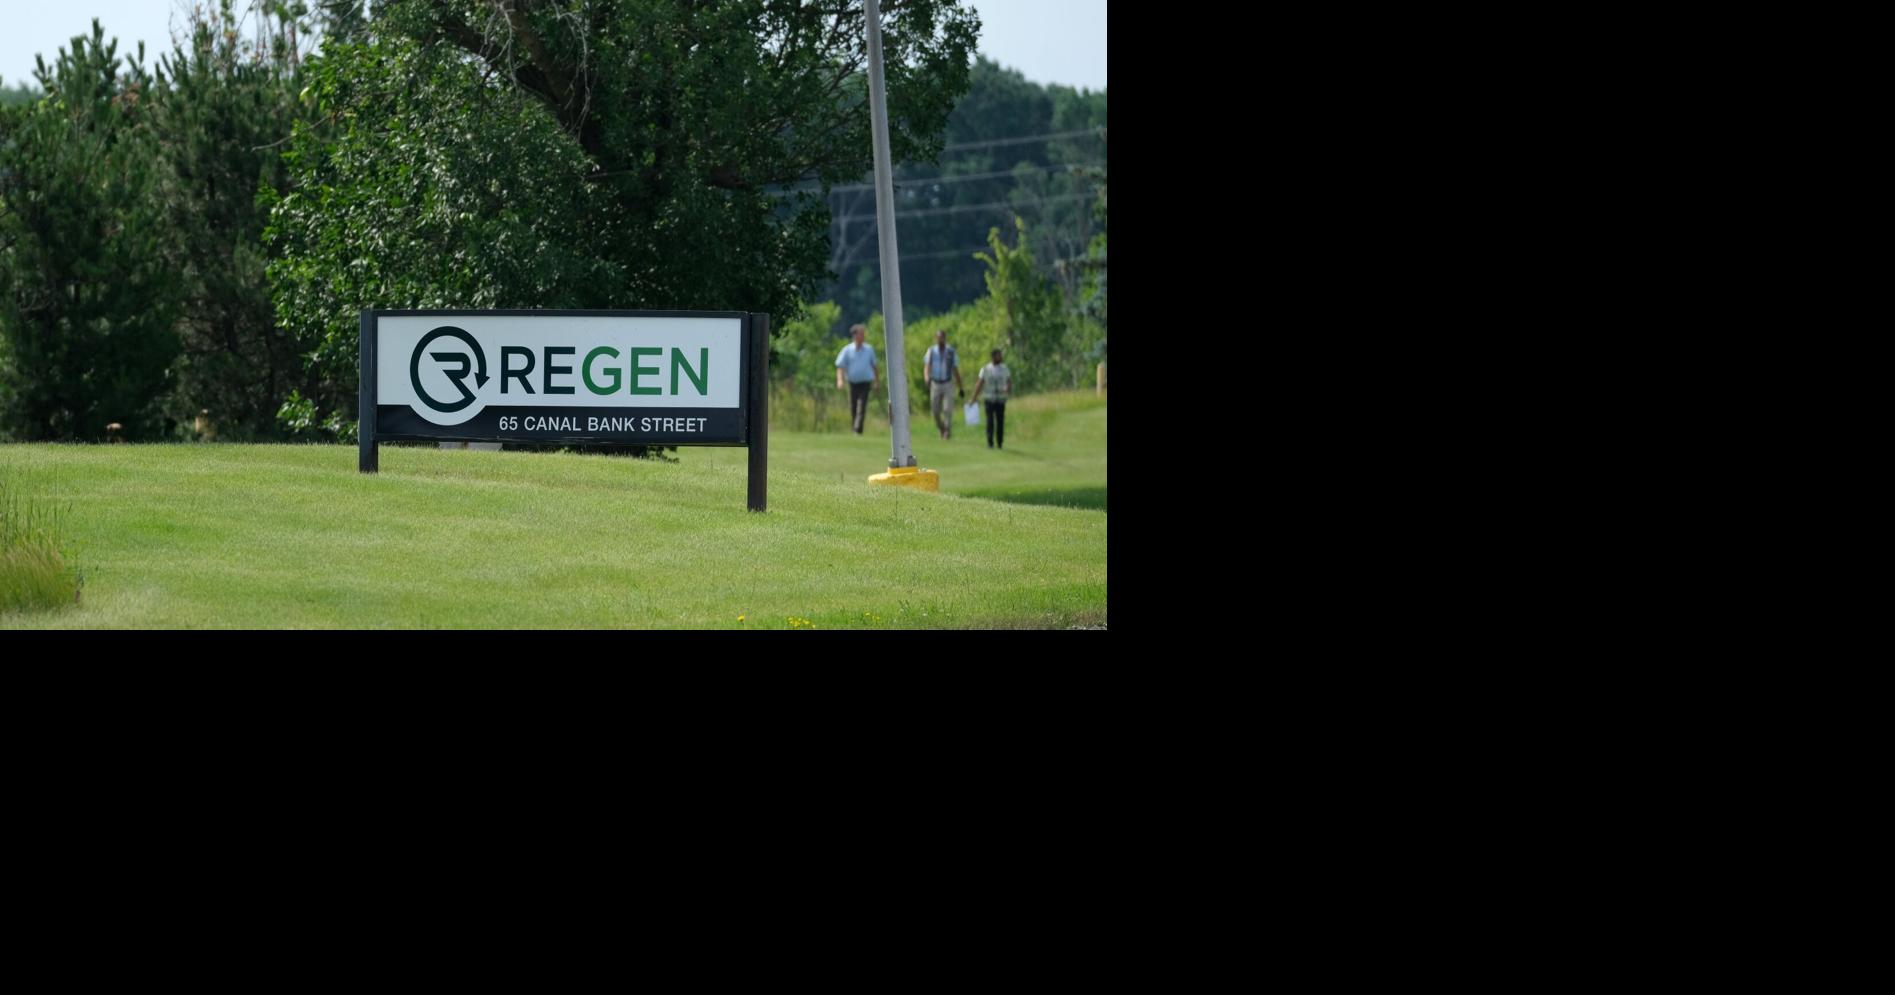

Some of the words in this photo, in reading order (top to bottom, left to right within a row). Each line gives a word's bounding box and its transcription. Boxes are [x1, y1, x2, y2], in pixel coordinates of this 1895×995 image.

[499, 345, 709, 396] REGEN
[499, 416, 518, 432] 65
[524, 416, 582, 432] CANAL
[588, 417, 635, 432] BANK
[641, 417, 707, 433] STREET
